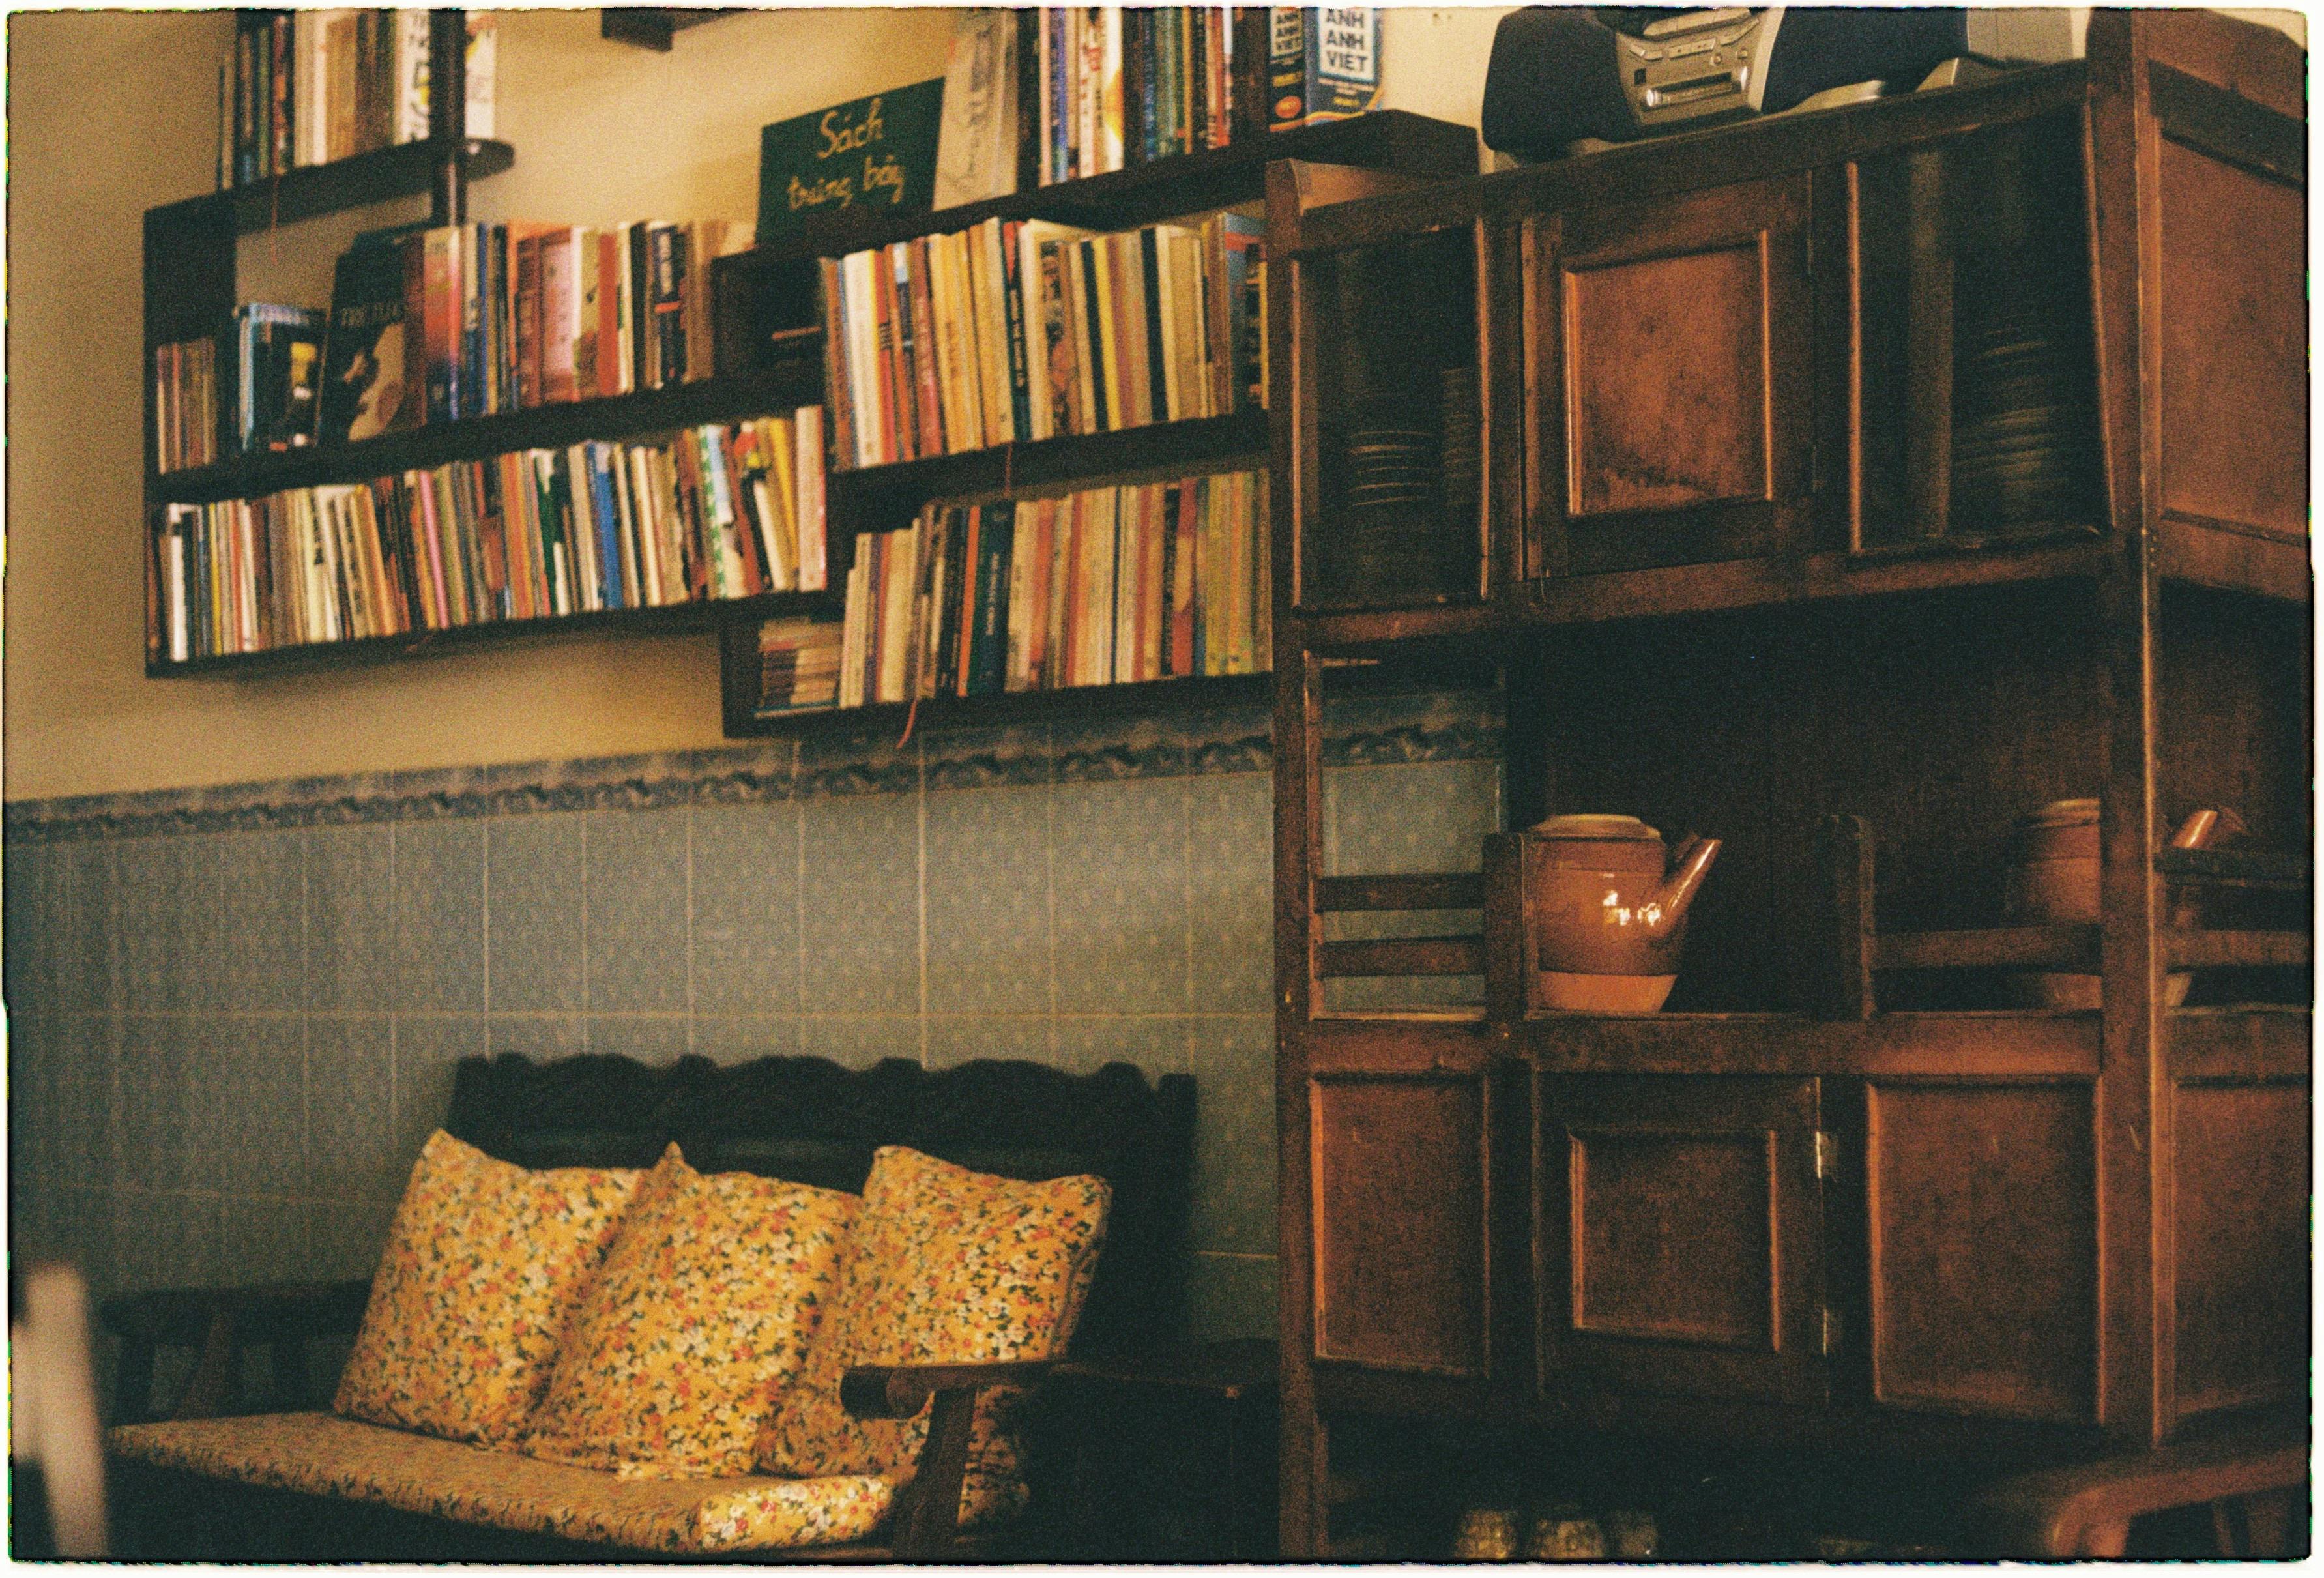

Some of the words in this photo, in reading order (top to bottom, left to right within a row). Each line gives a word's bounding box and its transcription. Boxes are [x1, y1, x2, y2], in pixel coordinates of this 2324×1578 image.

[1327, 8, 1364, 29] ANH
[1326, 29, 1365, 50] ANH
[818, 98, 883, 159] Sách
